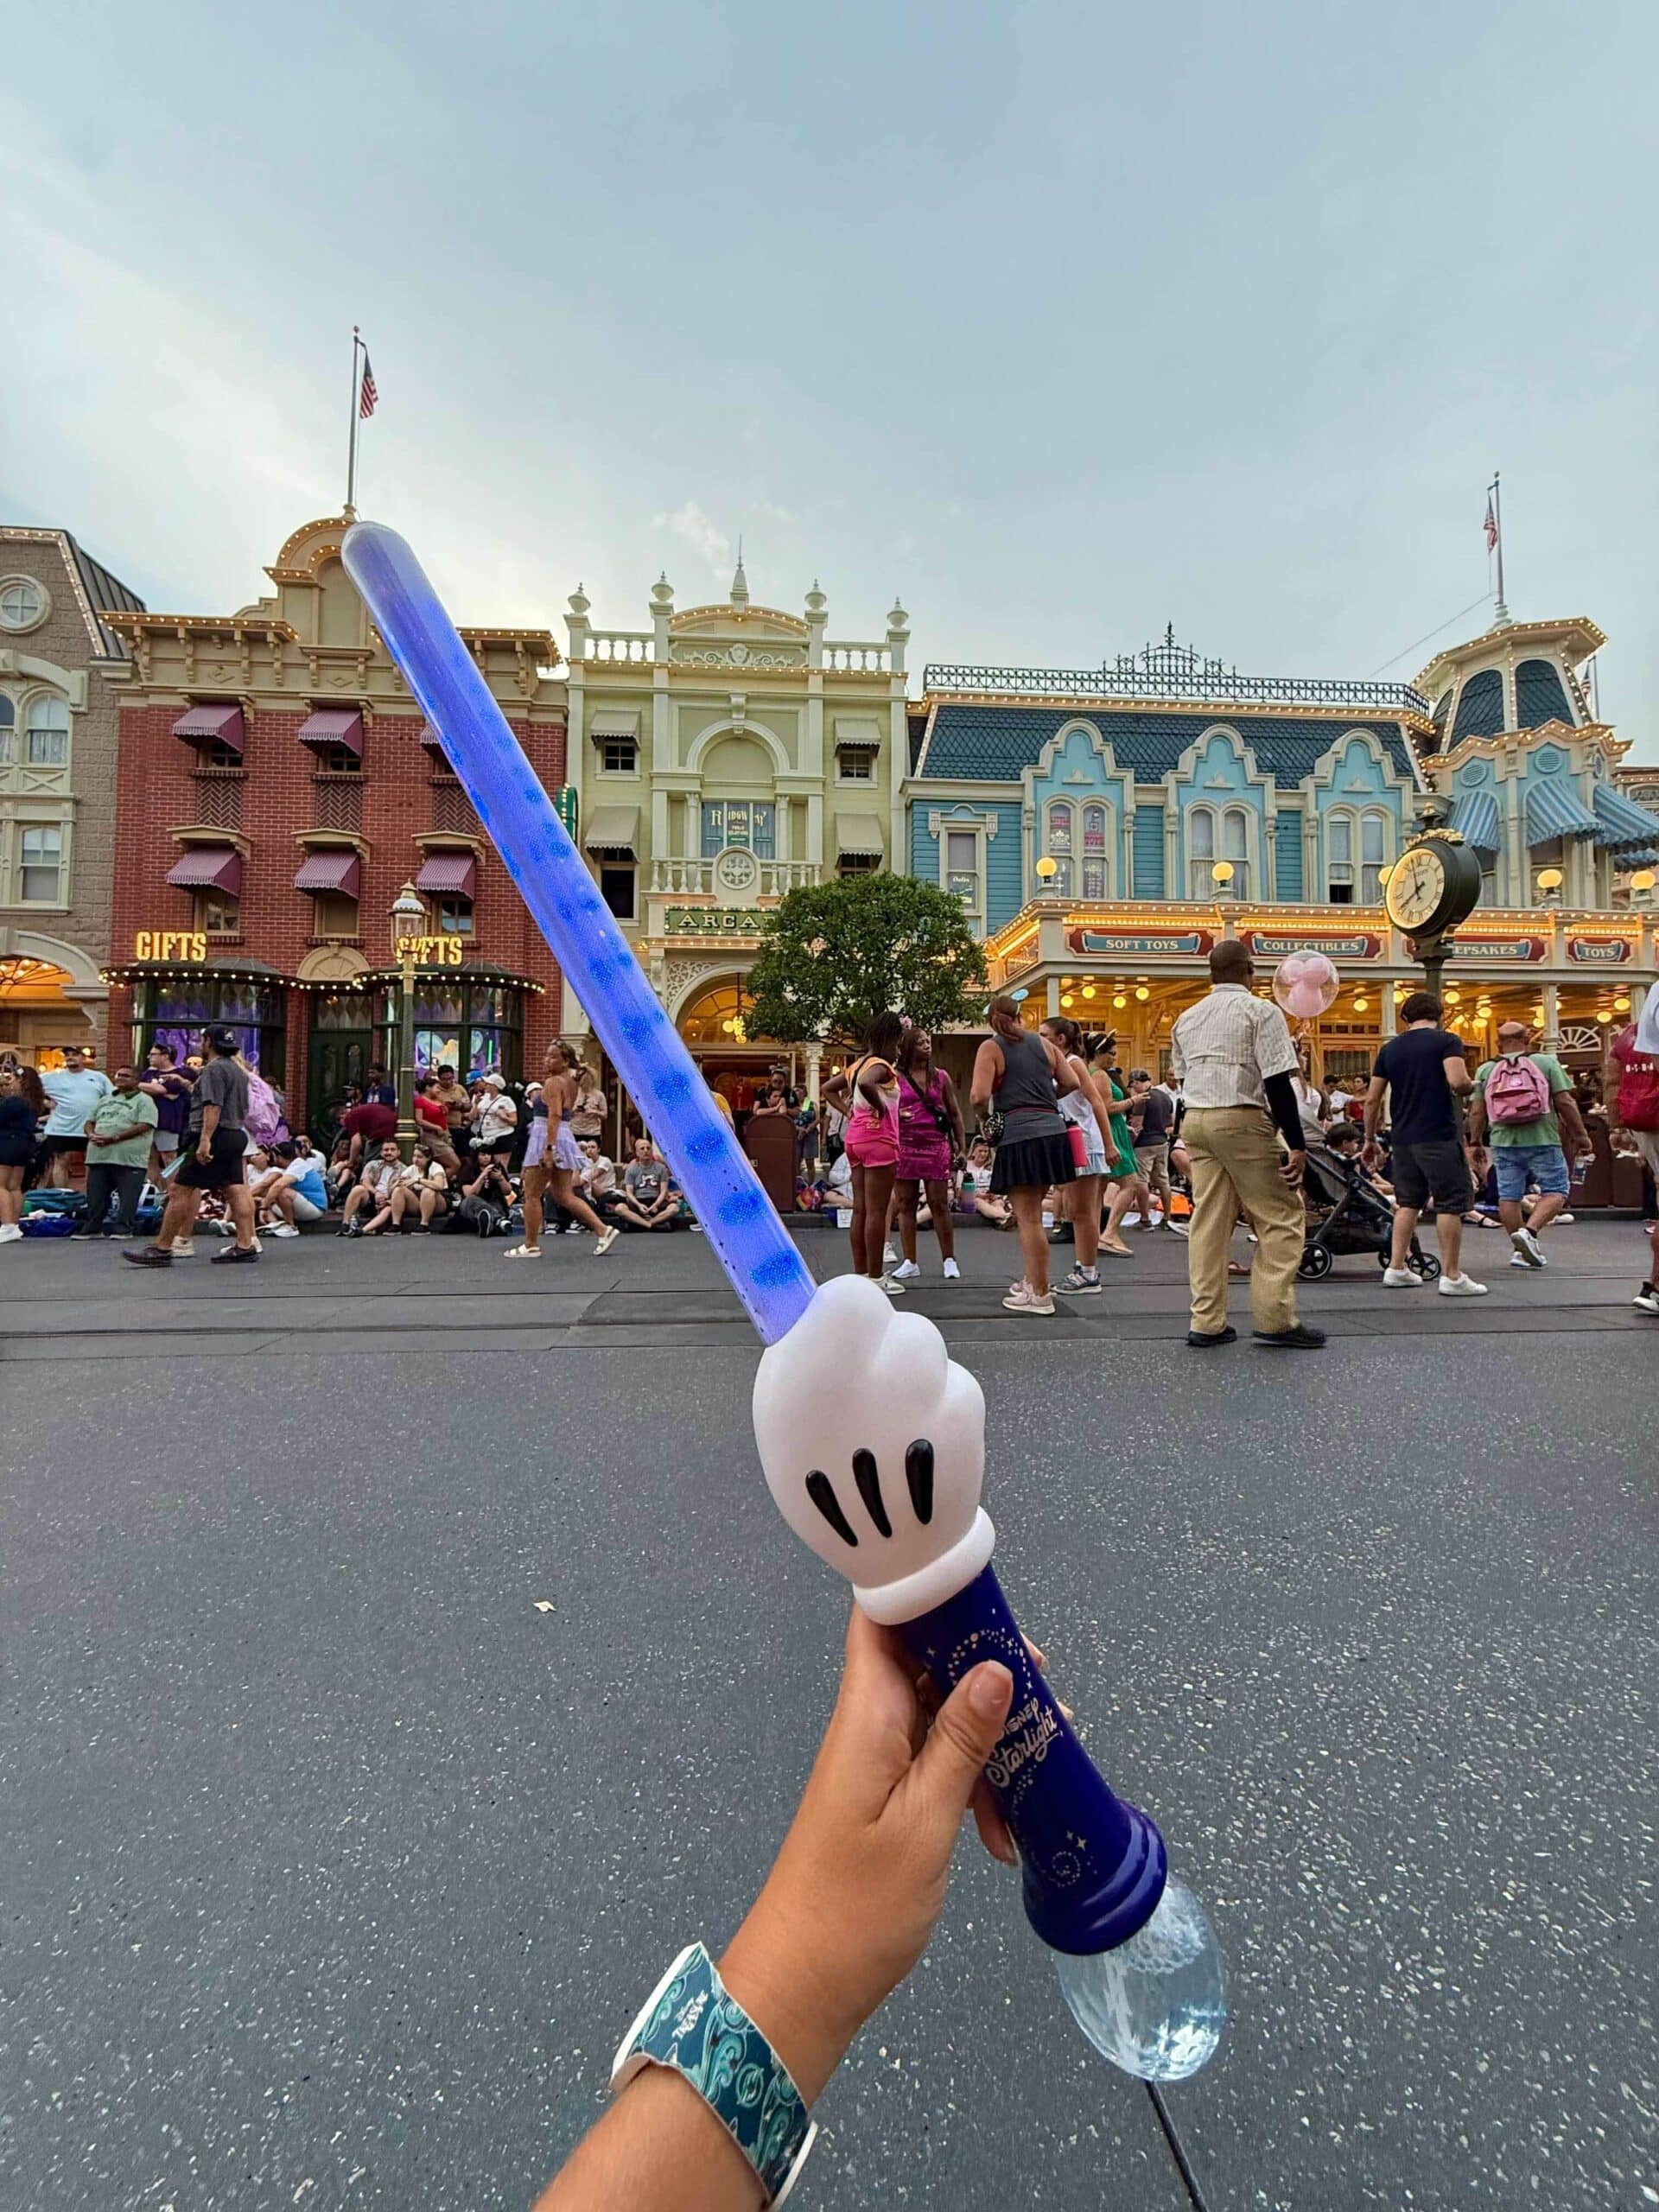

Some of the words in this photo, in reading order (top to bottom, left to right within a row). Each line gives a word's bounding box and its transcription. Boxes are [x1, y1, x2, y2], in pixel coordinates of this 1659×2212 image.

[677, 914, 776, 930] ARCA
[137, 931, 207, 962] GIFTS
[1105, 939, 1141, 950] SOFT
[1145, 940, 1179, 950] TOYS
[1262, 941, 1359, 951] COLLECTIBLES
[1452, 945, 1517, 955] EPSAKES
[1583, 947, 1616, 957] TOYS
[998, 1697, 1040, 1741] ISNEY
[986, 1705, 1064, 1788] Starlight
